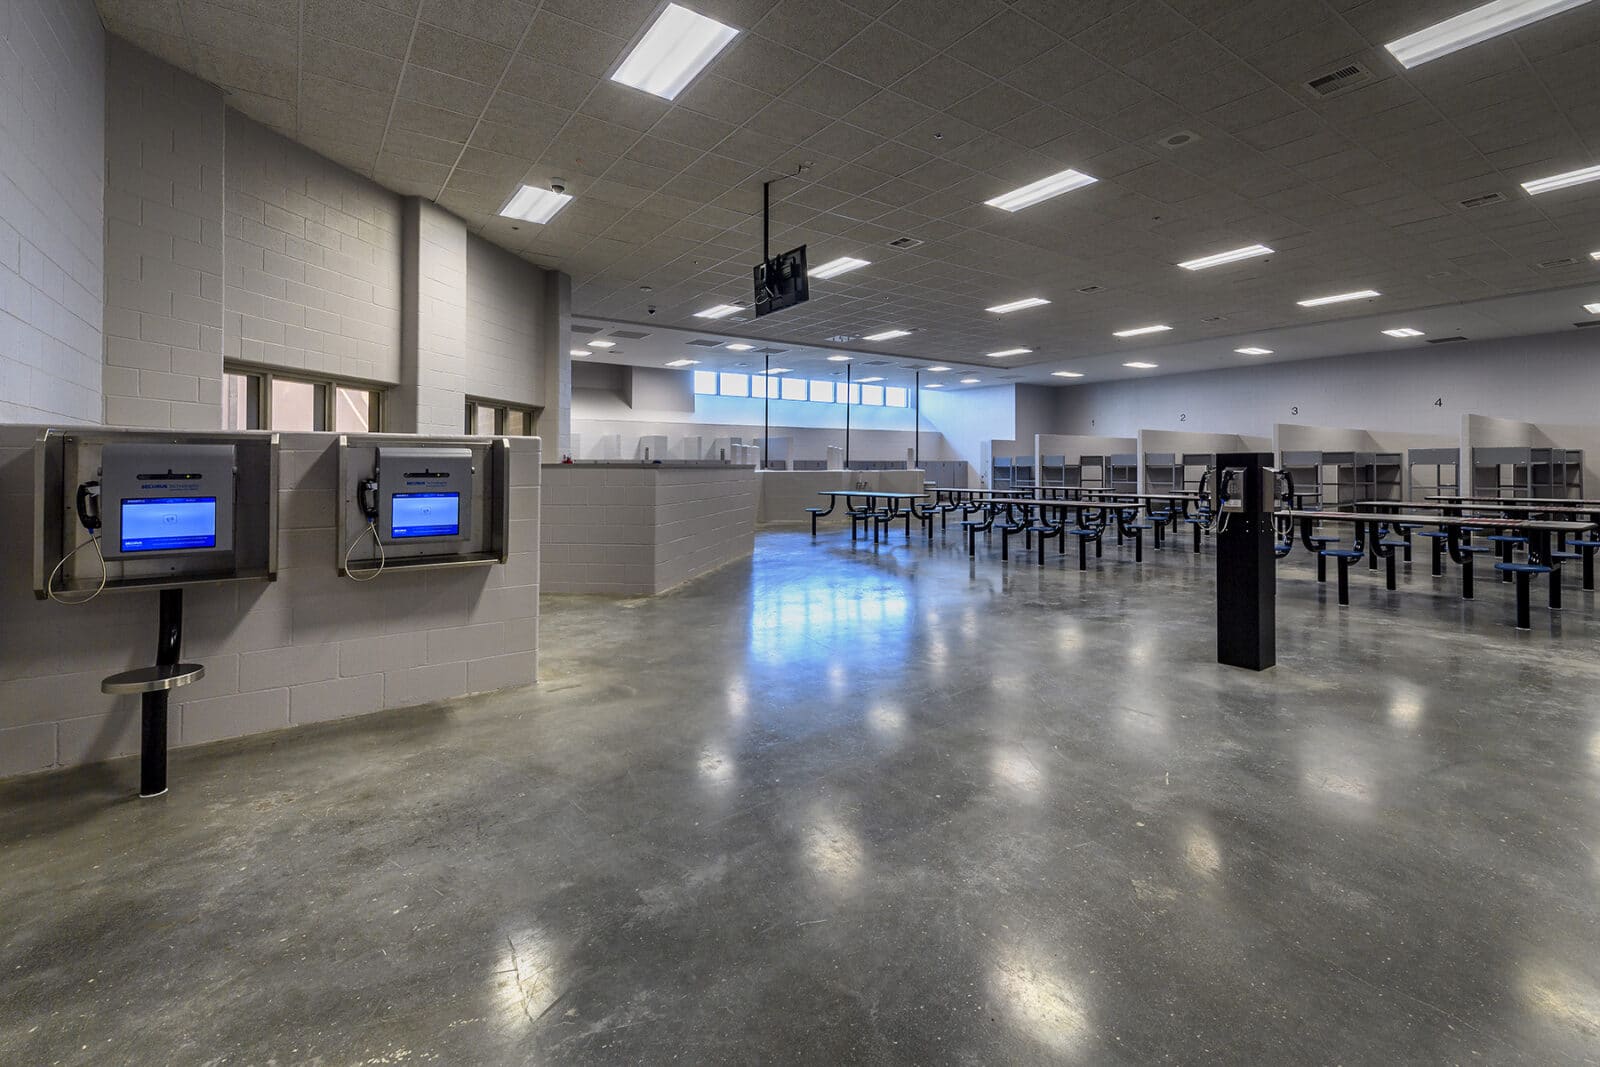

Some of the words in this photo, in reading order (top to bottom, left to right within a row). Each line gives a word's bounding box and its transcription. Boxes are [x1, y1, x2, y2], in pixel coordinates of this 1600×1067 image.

[1434, 398, 1443, 408] 4
[1291, 406, 1298, 415] 3
[1180, 413, 1186, 422] 2
